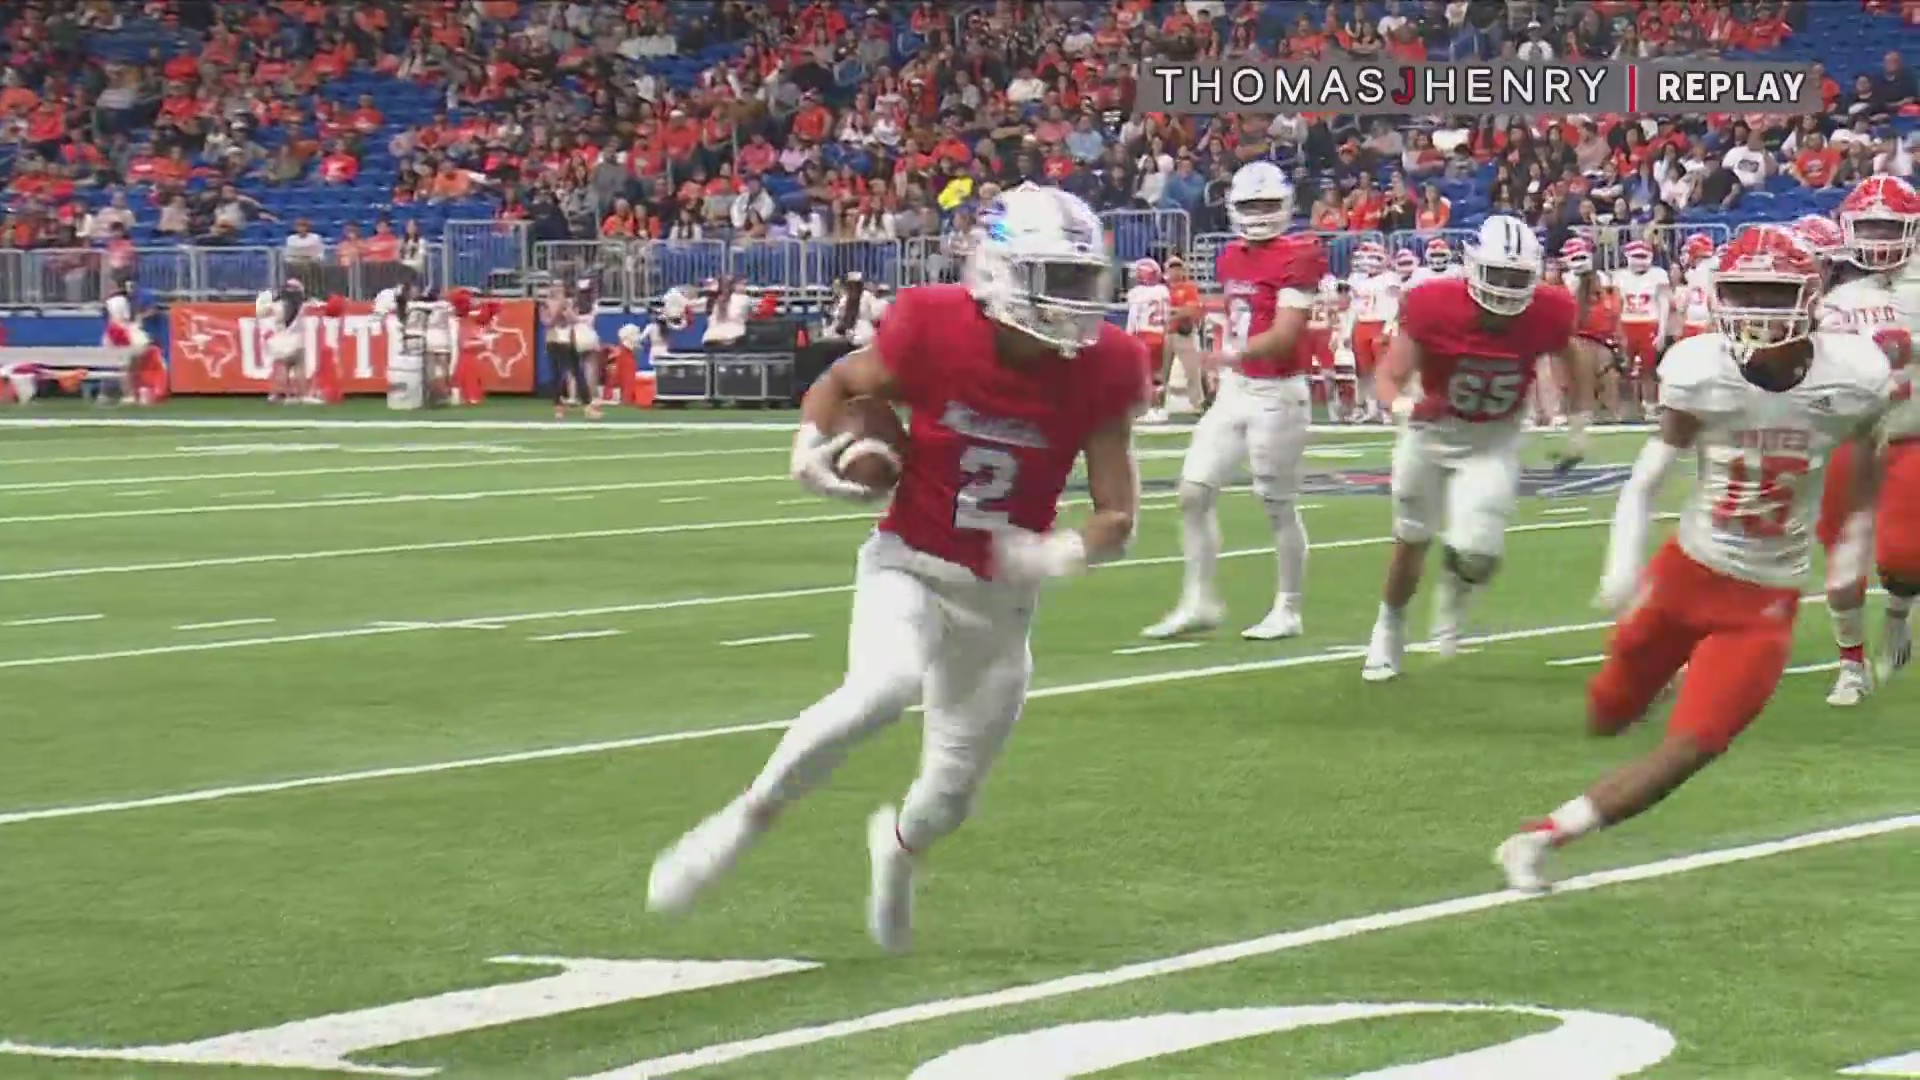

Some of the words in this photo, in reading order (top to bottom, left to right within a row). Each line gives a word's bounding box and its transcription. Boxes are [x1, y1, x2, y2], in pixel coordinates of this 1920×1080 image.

[1448, 373, 1523, 415] 65
[953, 446, 1019, 528] 2
[1711, 456, 1810, 538] 15
